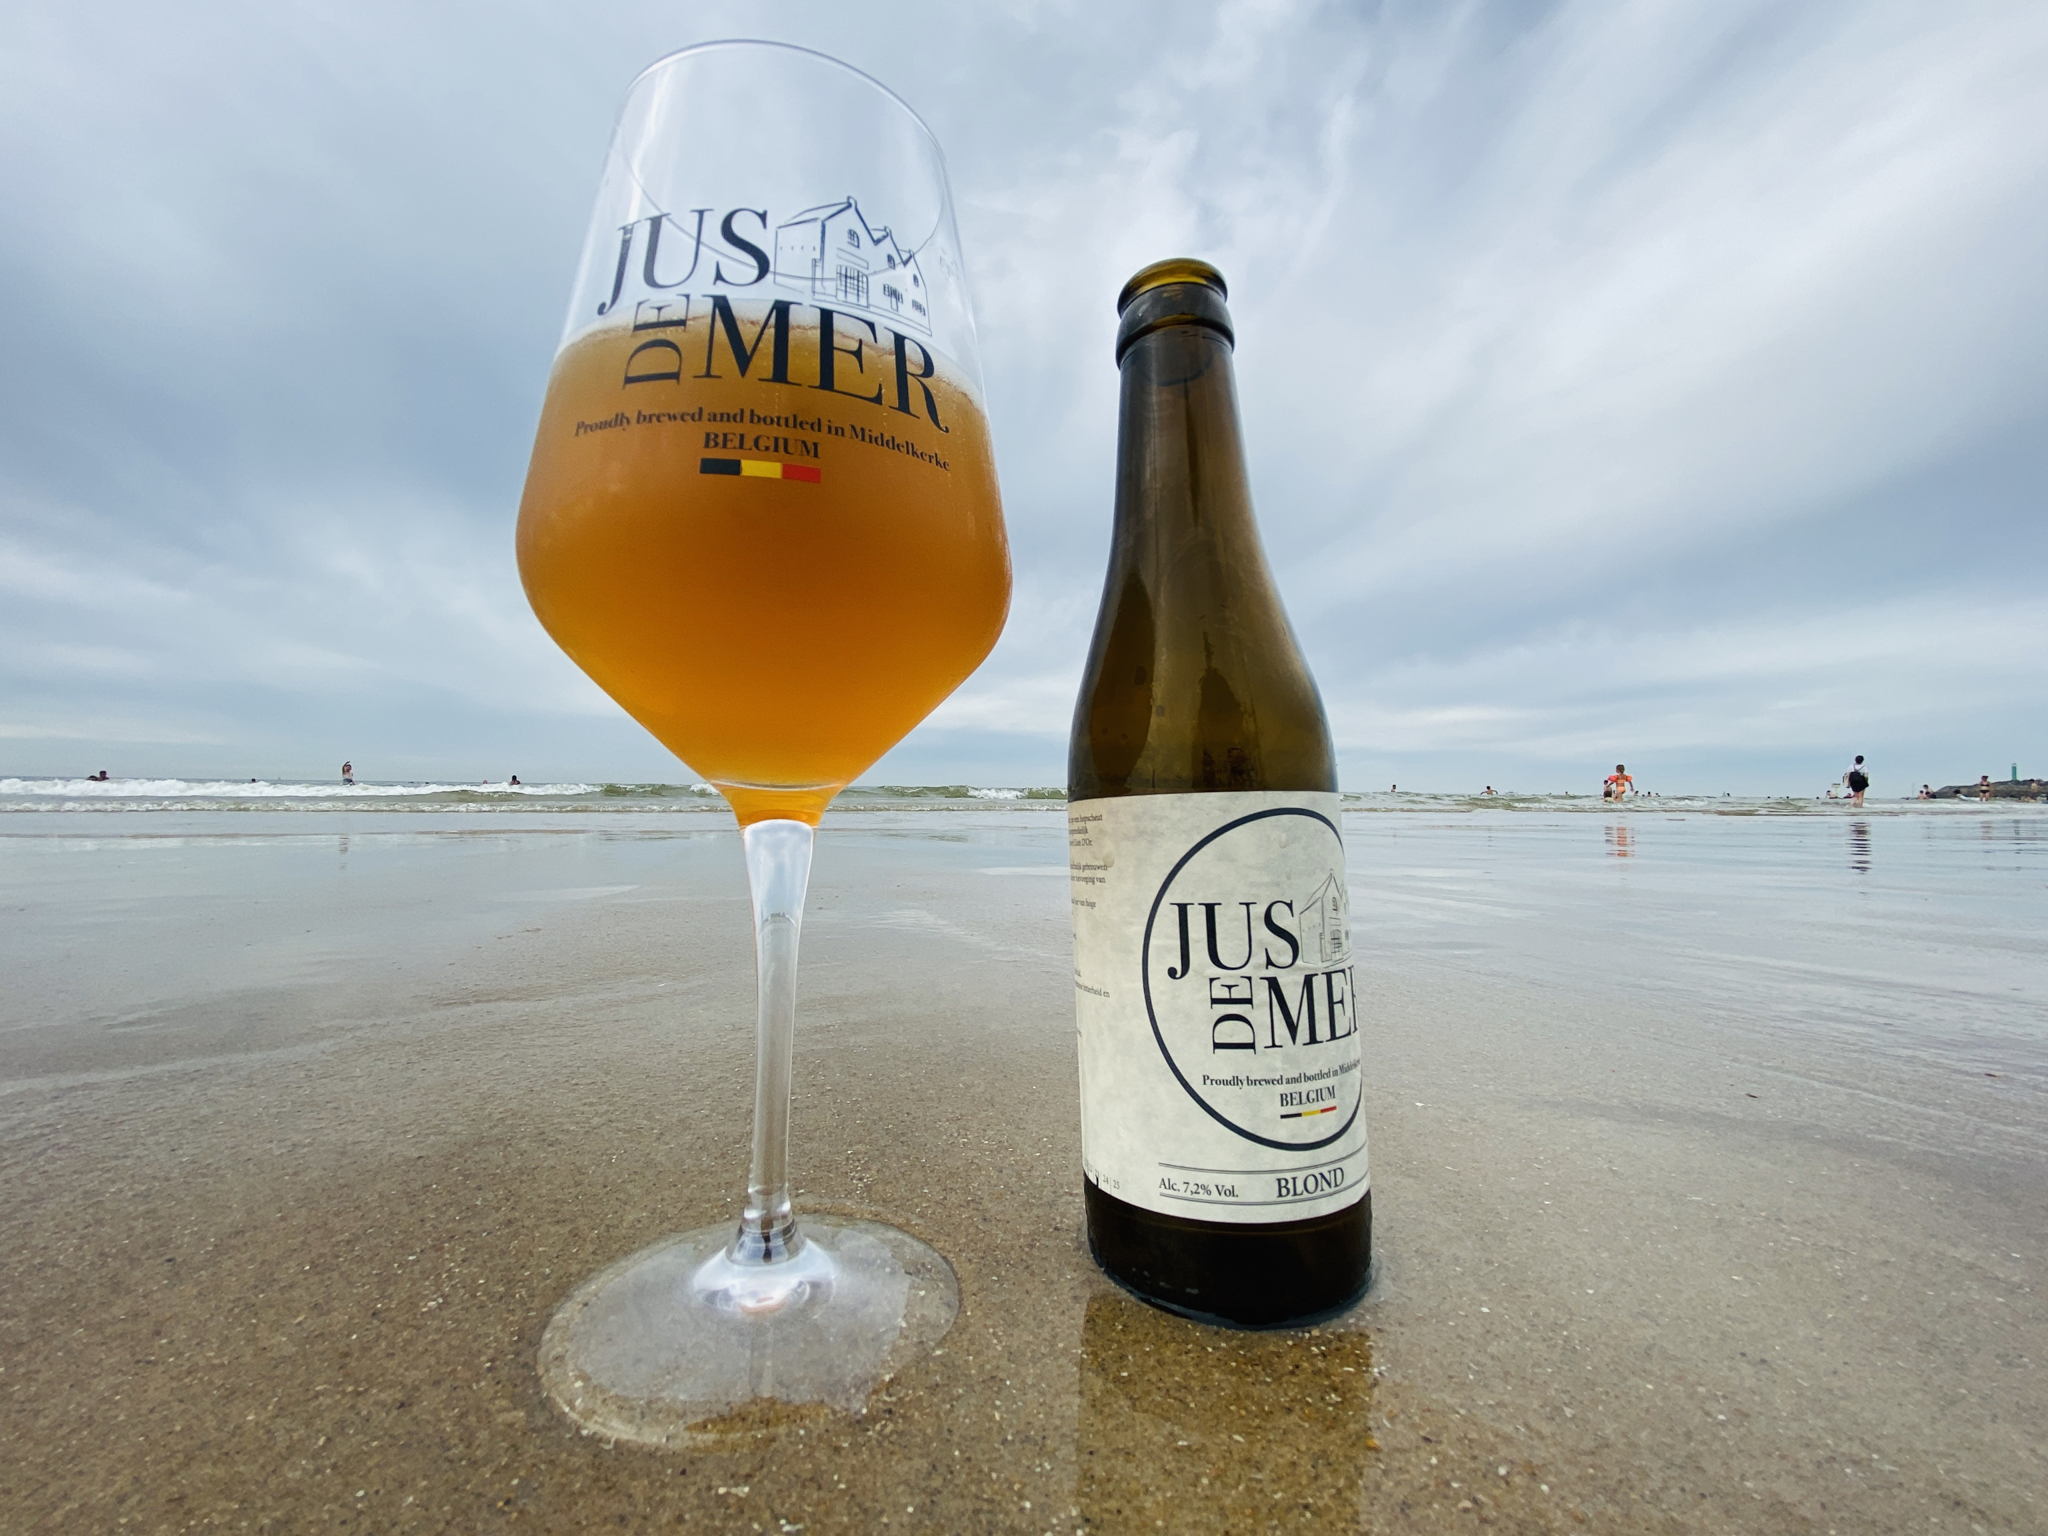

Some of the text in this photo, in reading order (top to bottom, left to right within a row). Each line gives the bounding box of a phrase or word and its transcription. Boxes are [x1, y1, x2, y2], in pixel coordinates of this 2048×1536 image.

[597, 208, 771, 315] JUS
[623, 293, 691, 390] DE
[693, 294, 949, 433] MER
[575, 407, 951, 472] Proudly brewed and bottled in Middelkerke
[703, 431, 821, 459] BELGIUM
[1167, 900, 1300, 980] JUS
[1209, 975, 1257, 1055] DE
[1202, 1074, 1245, 1090] Proudly
[1246, 1075, 1284, 1086] brewed
[1285, 1073, 1303, 1085] and
[1303, 1067, 1332, 1083] bottled
[1332, 1069, 1339, 1077] in
[1279, 1085, 1336, 1107] BELGIUM
[1158, 1178, 1239, 1198] Alc. 7,2% Vol.
[1275, 1167, 1345, 1199] BLOND
